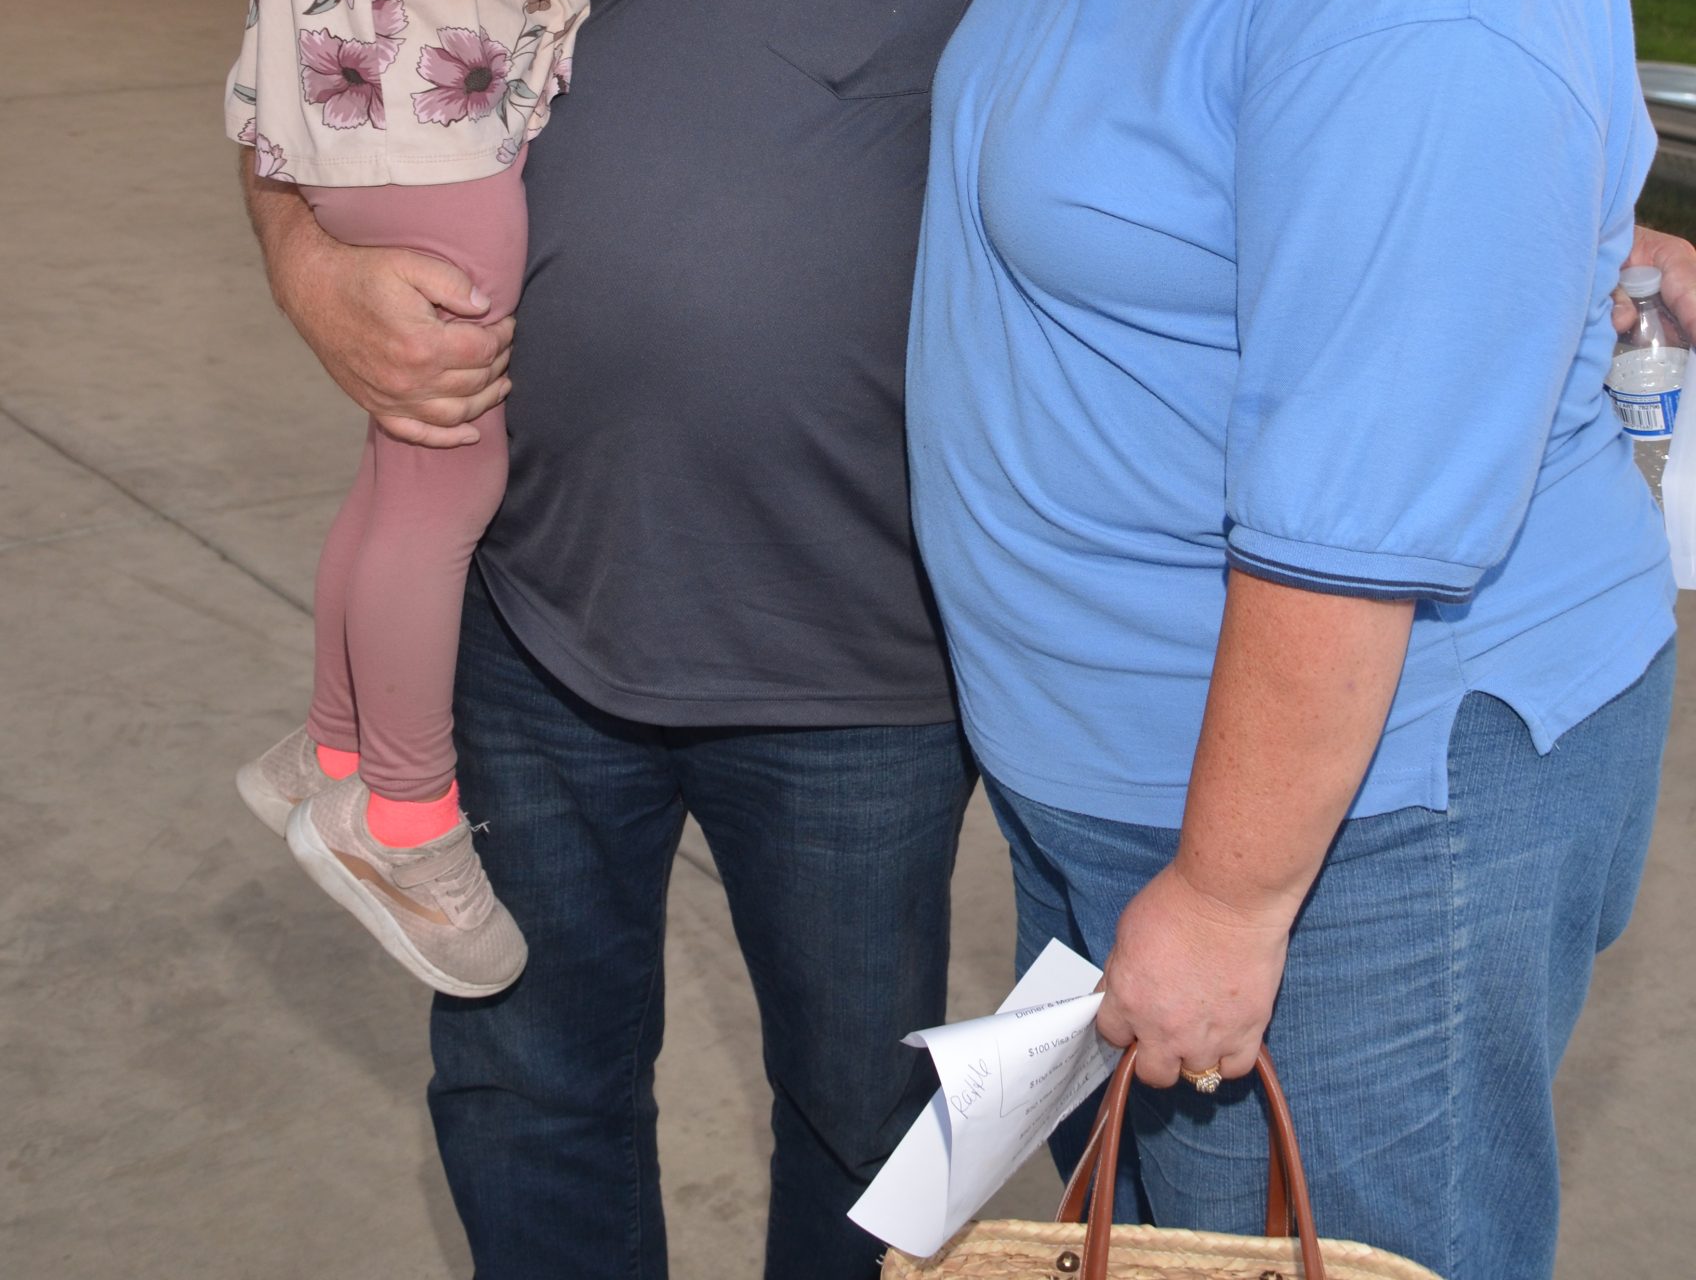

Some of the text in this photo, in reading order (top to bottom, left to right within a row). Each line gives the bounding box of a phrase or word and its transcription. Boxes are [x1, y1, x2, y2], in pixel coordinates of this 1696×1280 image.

[1015, 1005, 1046, 1019] Dinner
[1028, 1042, 1050, 1057] $100
[1051, 1035, 1070, 1048] Visa
